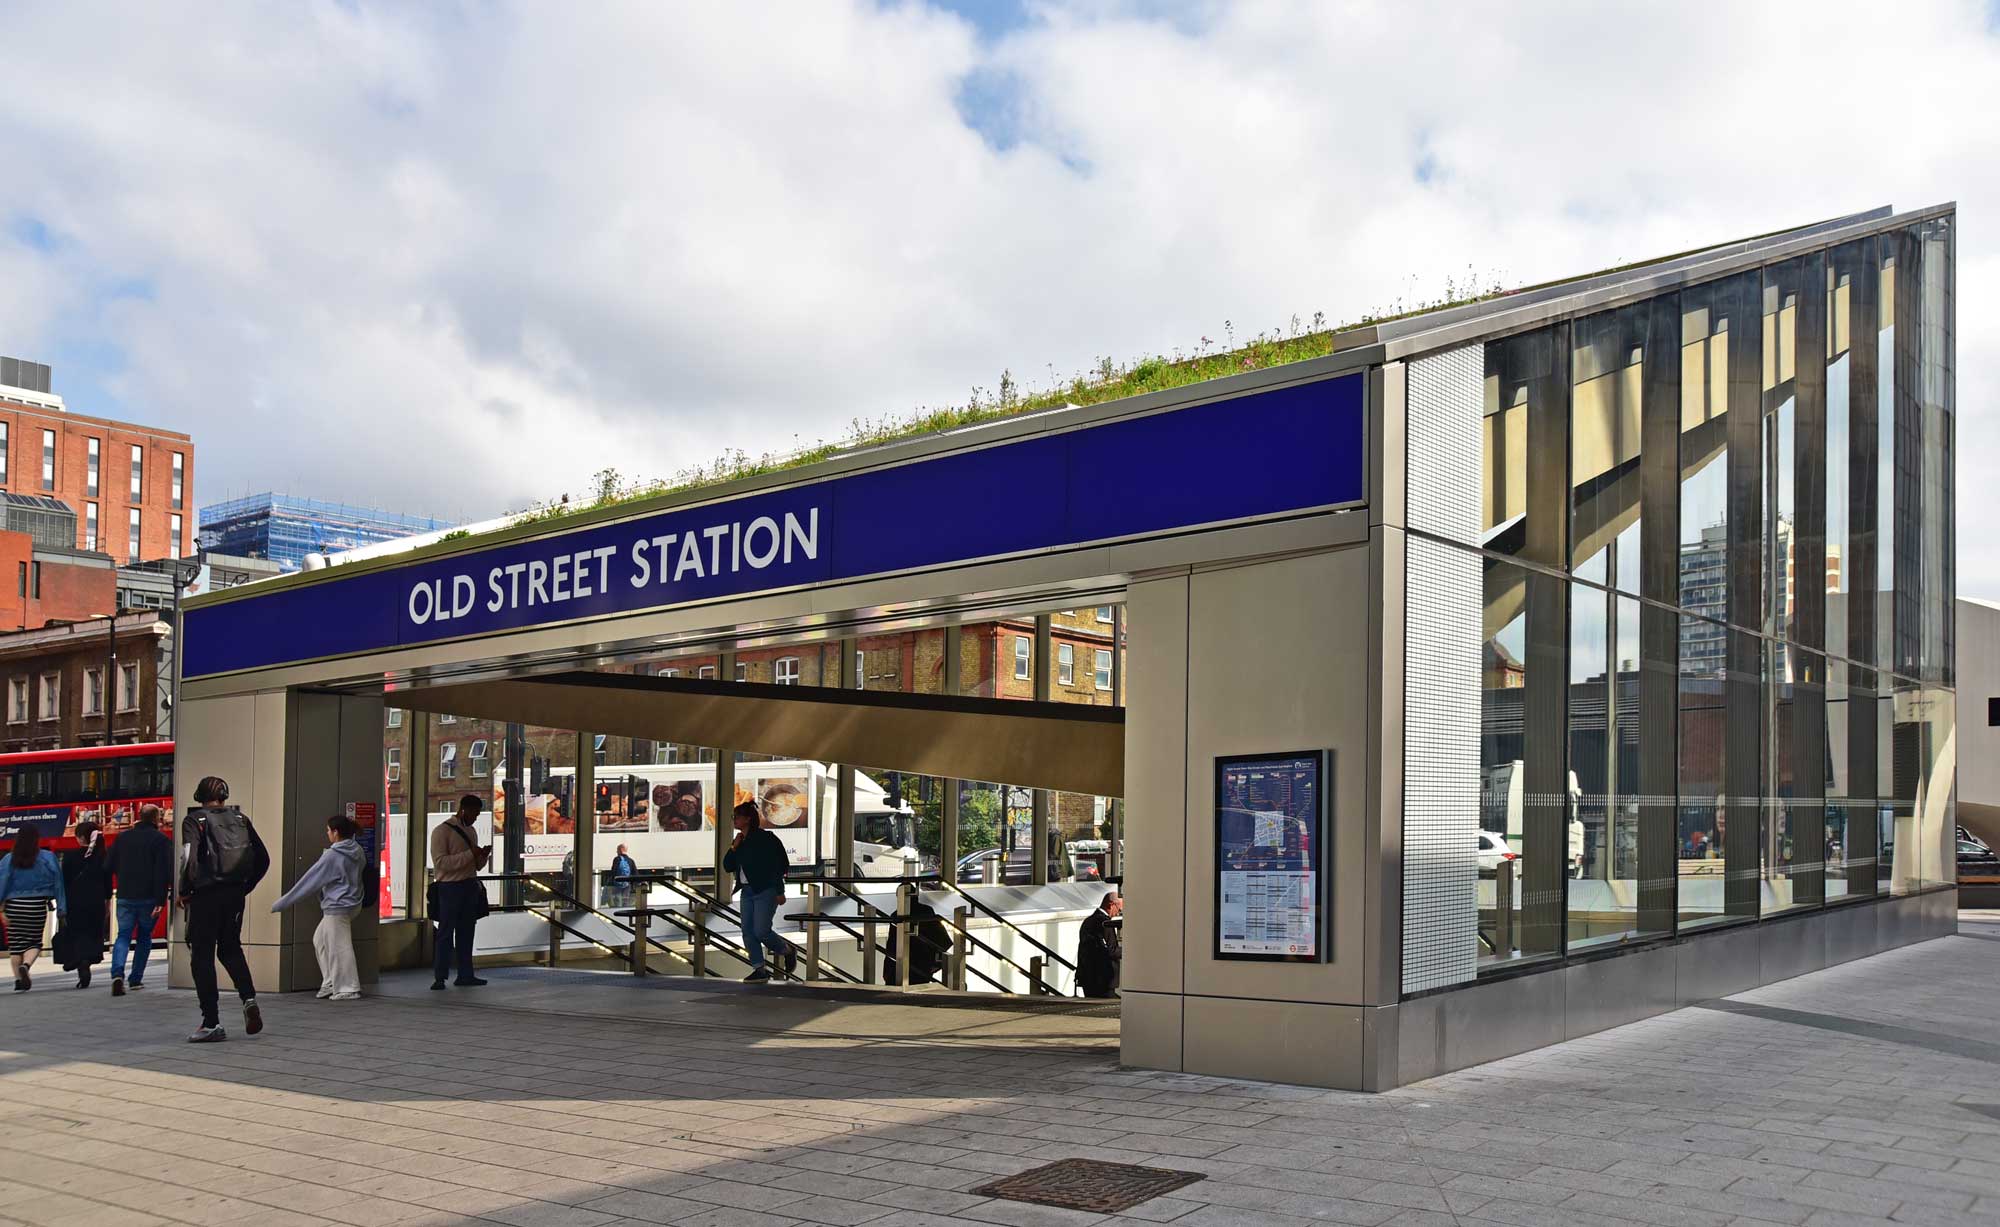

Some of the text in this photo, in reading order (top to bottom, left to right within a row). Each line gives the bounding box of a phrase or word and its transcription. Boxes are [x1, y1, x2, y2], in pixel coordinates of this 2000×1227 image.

[408, 507, 819, 625] OLD STREET STATION
